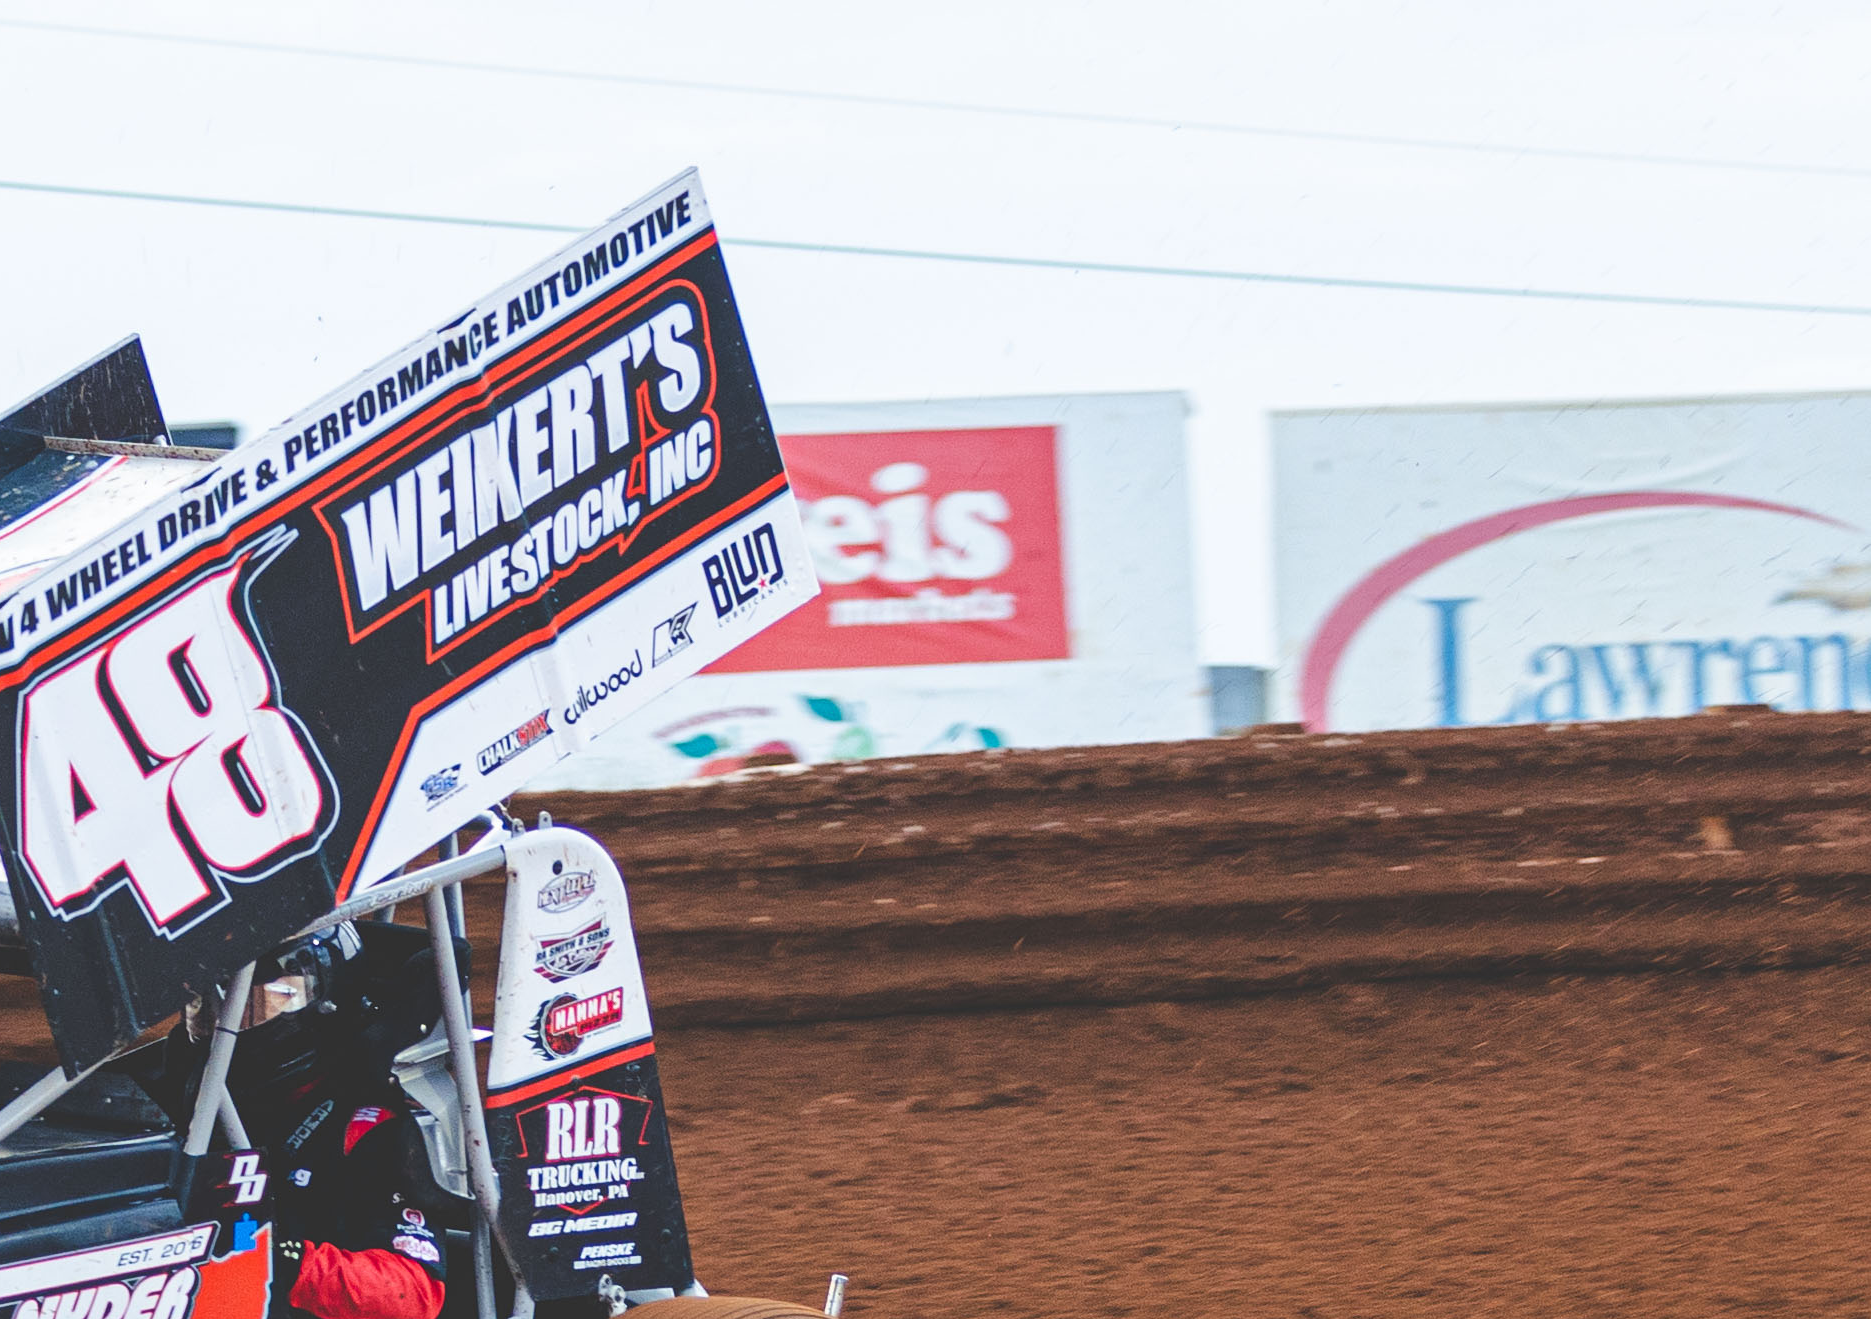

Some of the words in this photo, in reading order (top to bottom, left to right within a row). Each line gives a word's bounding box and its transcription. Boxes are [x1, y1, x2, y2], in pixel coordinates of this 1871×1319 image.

[44, 531, 152, 621] WHEEL
[157, 468, 248, 551] DRIVE
[255, 459, 278, 491] &
[283, 312, 500, 475] PERFORMANCE
[506, 190, 692, 339] AUTOMOTIVE
[340, 302, 702, 613] WEIKERT'S
[433, 468, 641, 645] LIVESTOCK,
[648, 418, 712, 506] INC
[797, 461, 1014, 586] eis
[1417, 598, 1871, 727] Lawren
[19, 552, 328, 930] 48
[527, 1157, 637, 1191] TRUCKING
[545, 1097, 620, 1160] RLR
[117, 1247, 153, 1267] EST.
[535, 1188, 604, 1207] Hanover,
[608, 1184, 629, 1199] PA
[563, 1212, 638, 1234] MEDIA
